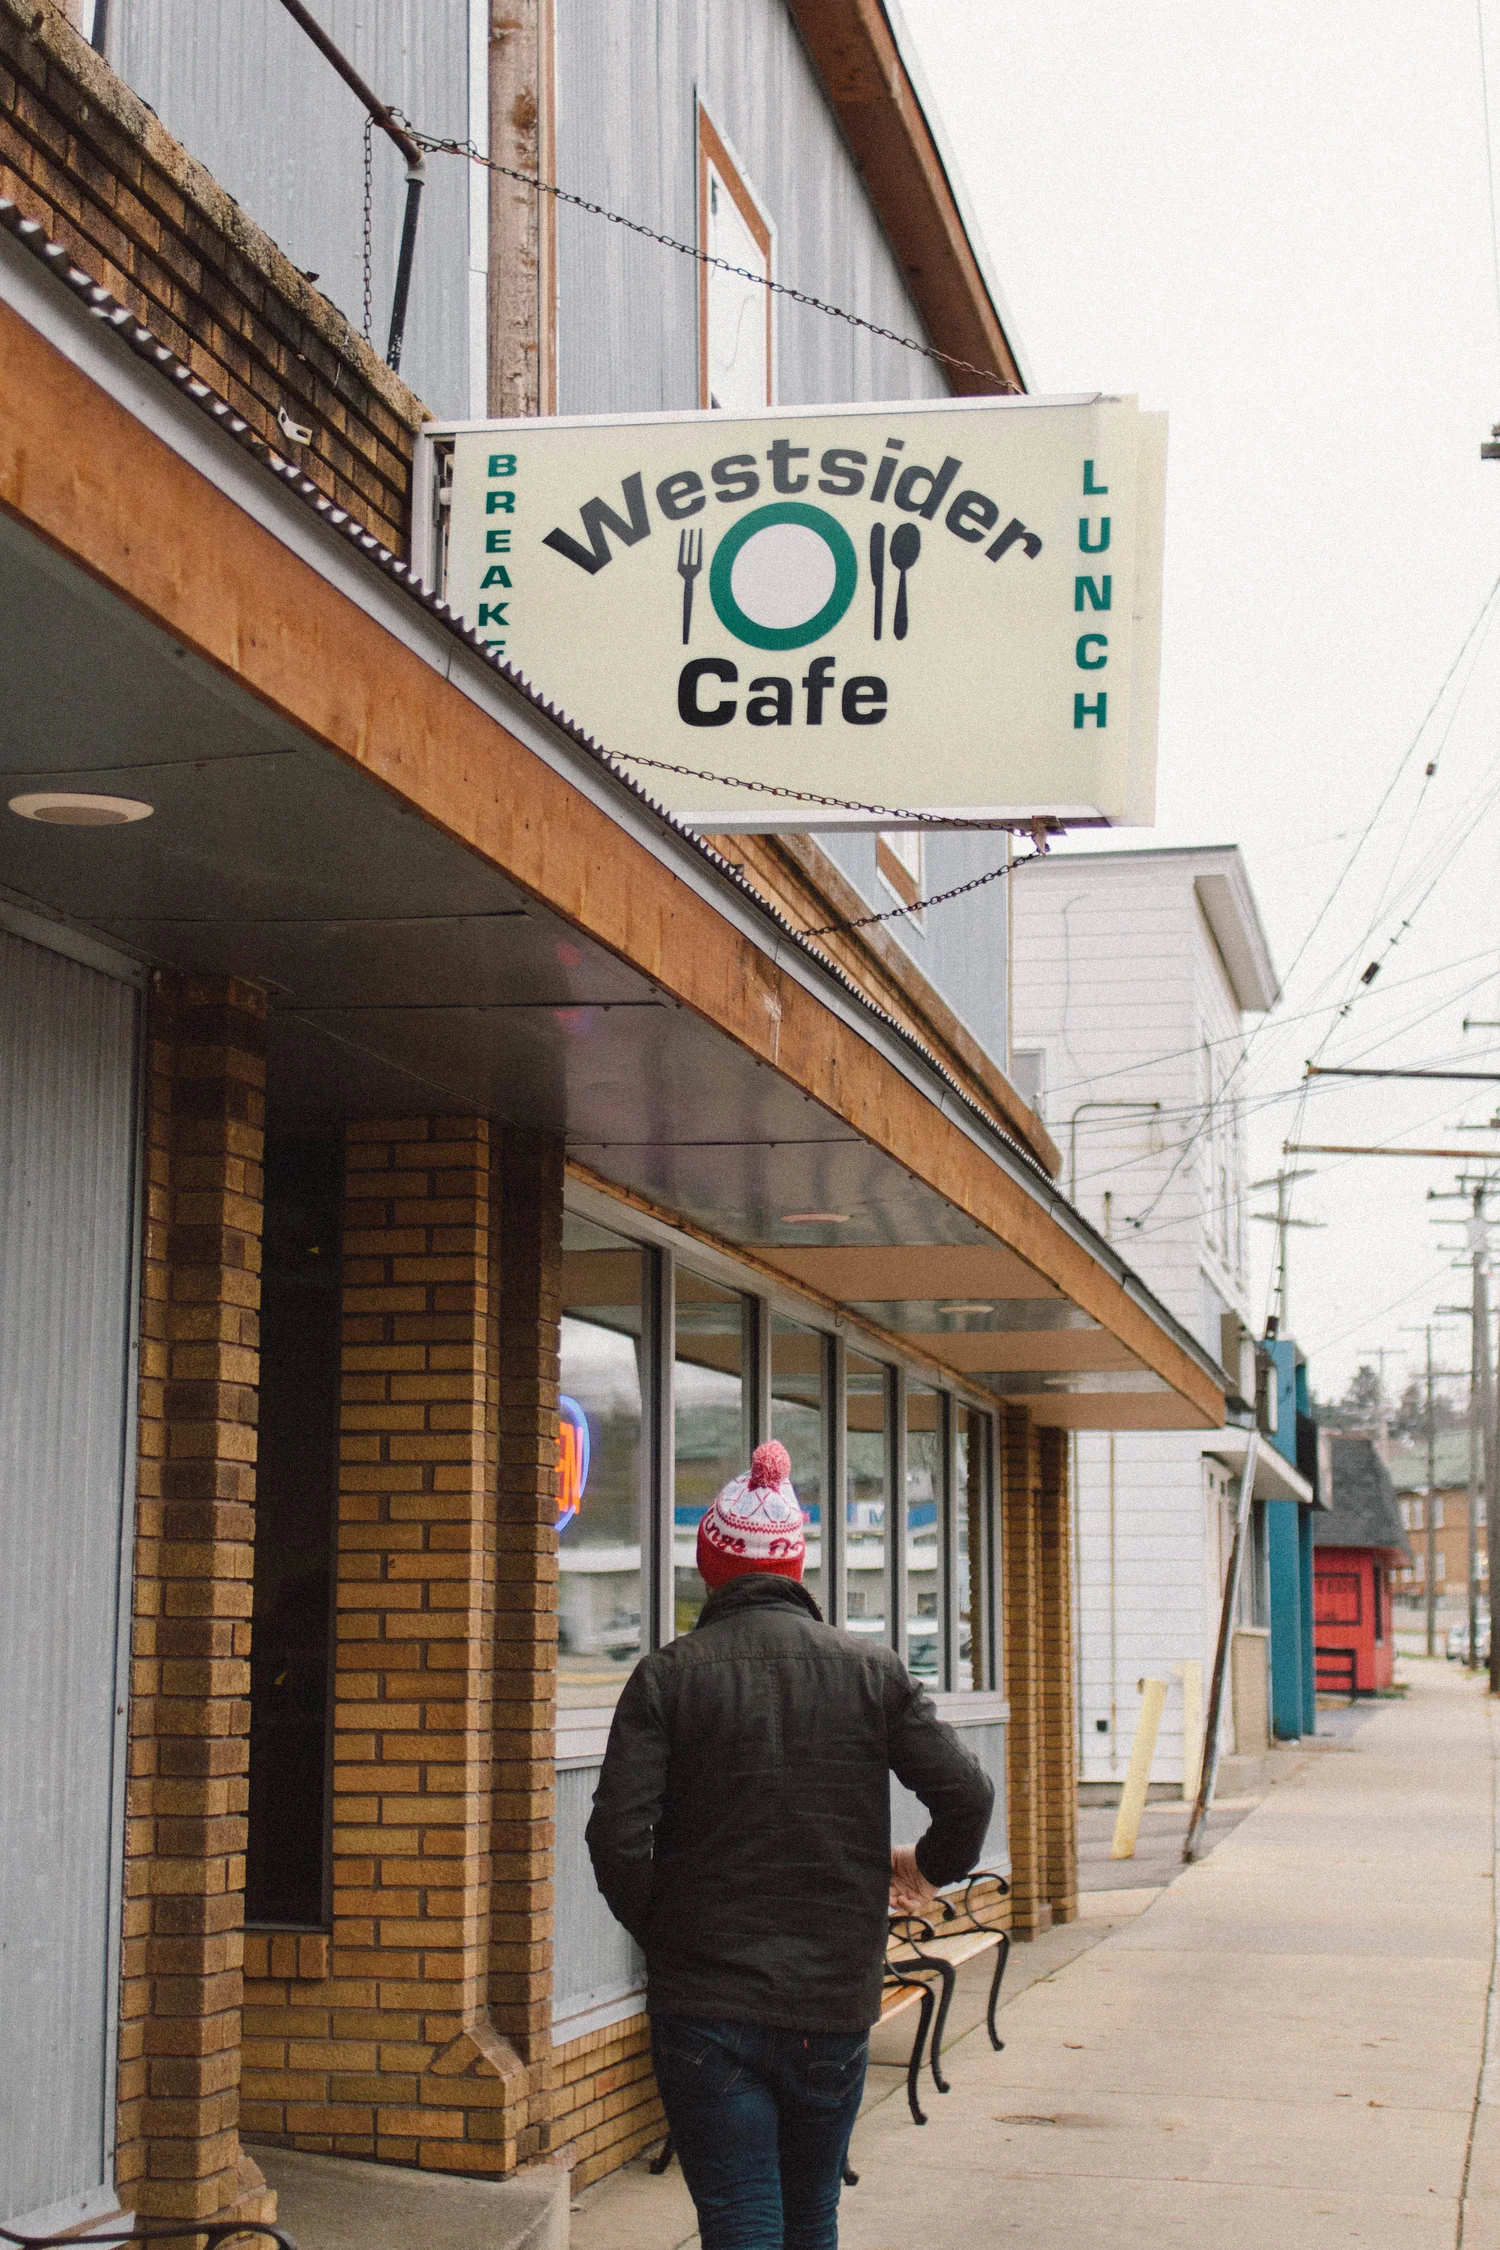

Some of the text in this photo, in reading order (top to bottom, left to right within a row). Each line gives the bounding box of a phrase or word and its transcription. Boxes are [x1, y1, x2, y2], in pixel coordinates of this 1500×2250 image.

[541, 437, 1043, 576] Westsider
[1073, 459, 1113, 729] LUNCH
[677, 655, 889, 728] Cafe
